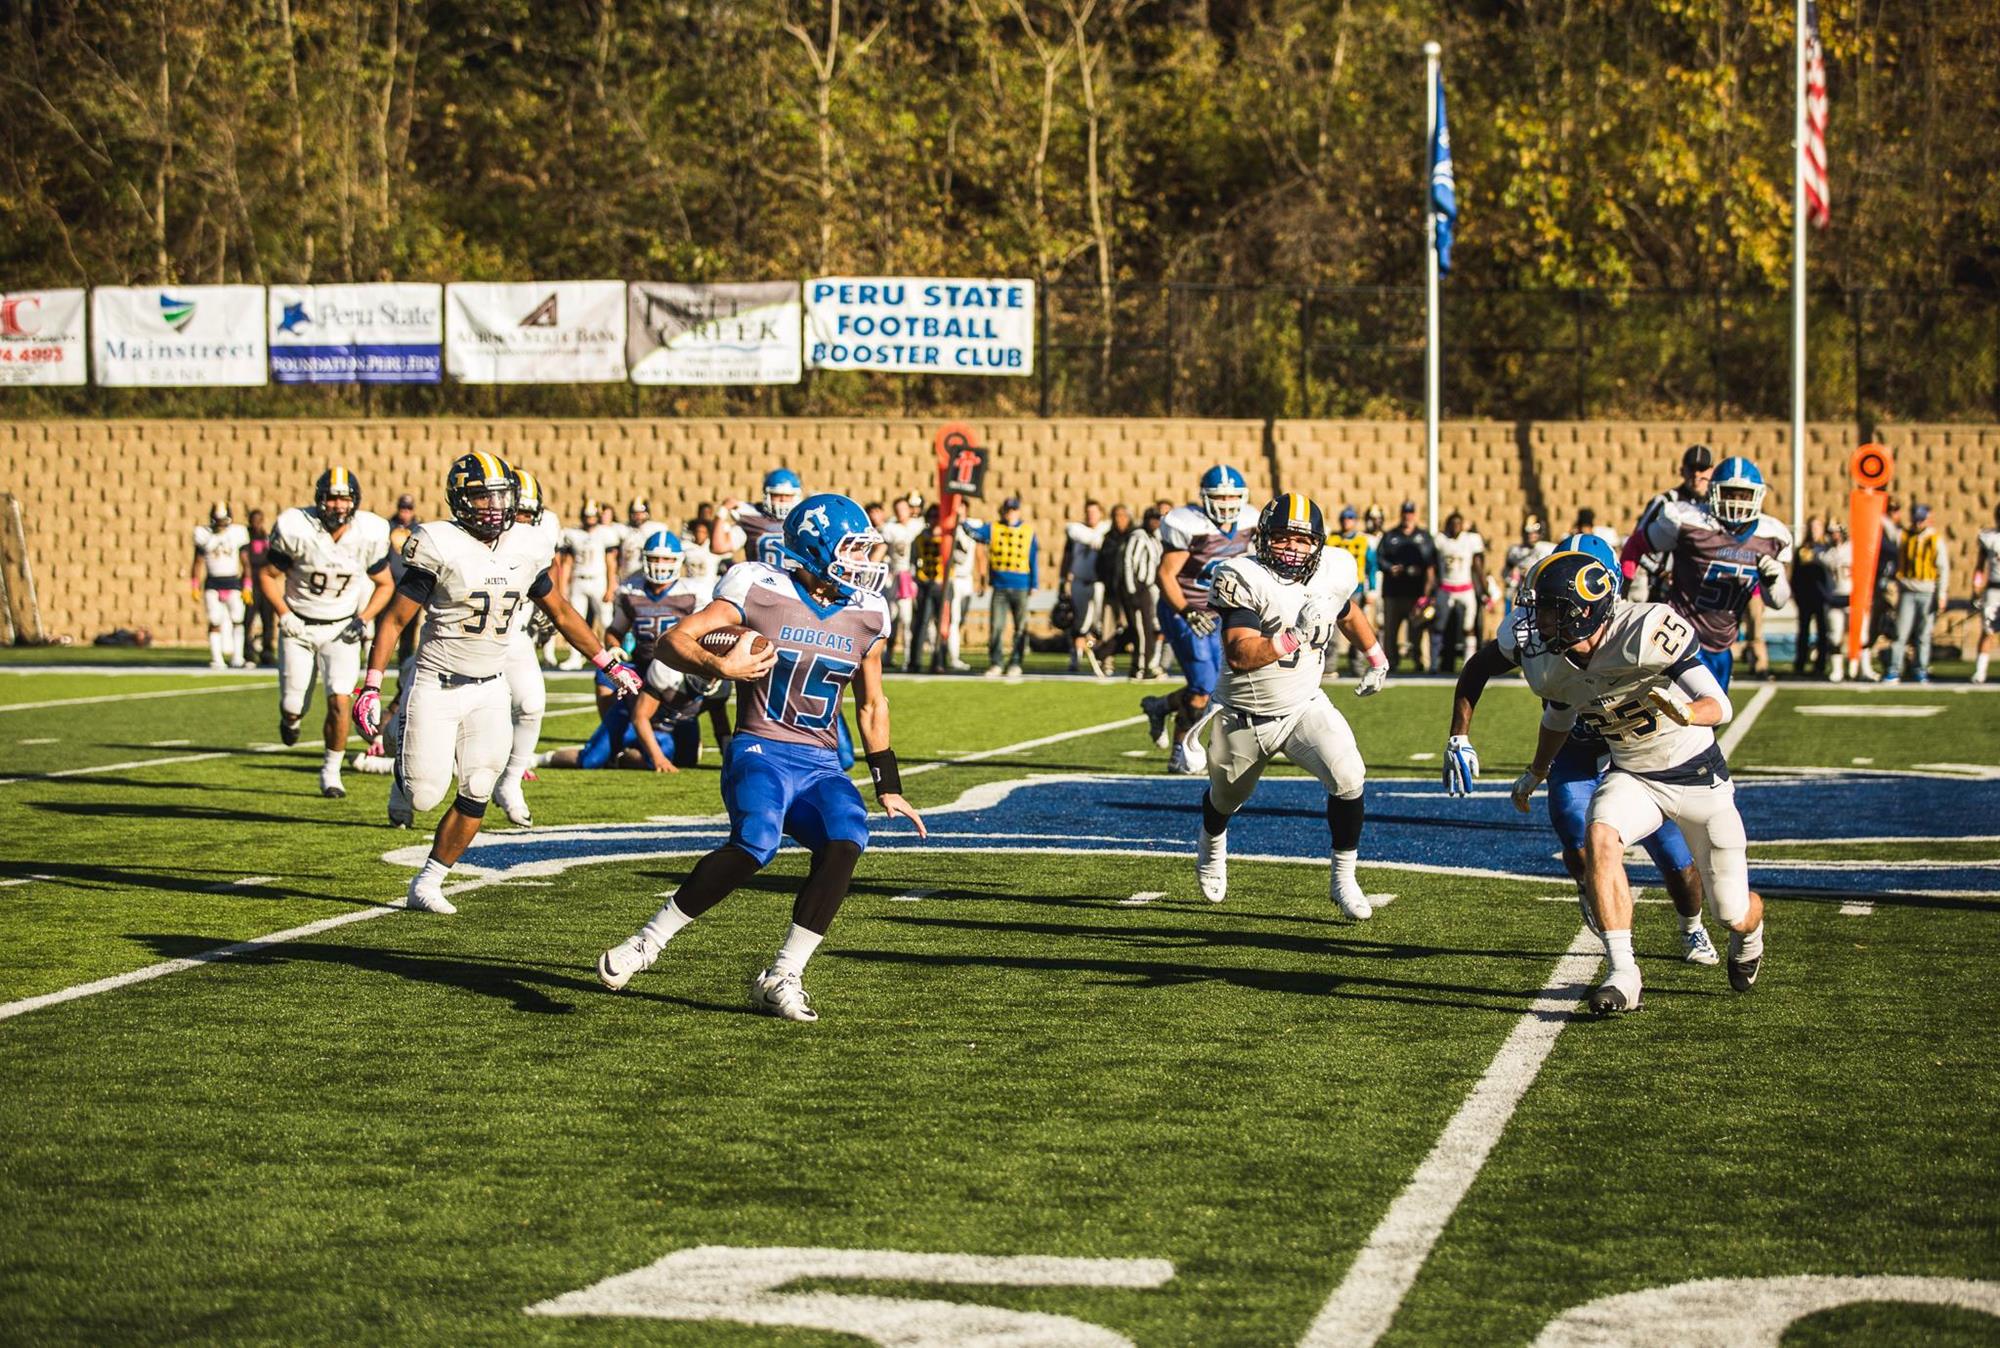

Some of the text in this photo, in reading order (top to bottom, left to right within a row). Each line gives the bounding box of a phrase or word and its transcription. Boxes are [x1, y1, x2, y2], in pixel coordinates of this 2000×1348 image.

[814, 284, 1024, 308] PERU STATE
[316, 301, 436, 327] Peru State
[838, 315, 999, 339] FOOTBALL
[104, 340, 255, 361] Mainstreet
[812, 343, 1023, 368] BOOSTER CLUB
[150, 368, 207, 380] BANK
[1213, 577, 1238, 602] 54
[1575, 561, 1612, 601] G
[1695, 560, 1761, 612] 57
[461, 590, 521, 636] 33
[780, 625, 853, 654] BOBCATS
[1652, 613, 1687, 656] 25
[764, 647, 858, 731] 15
